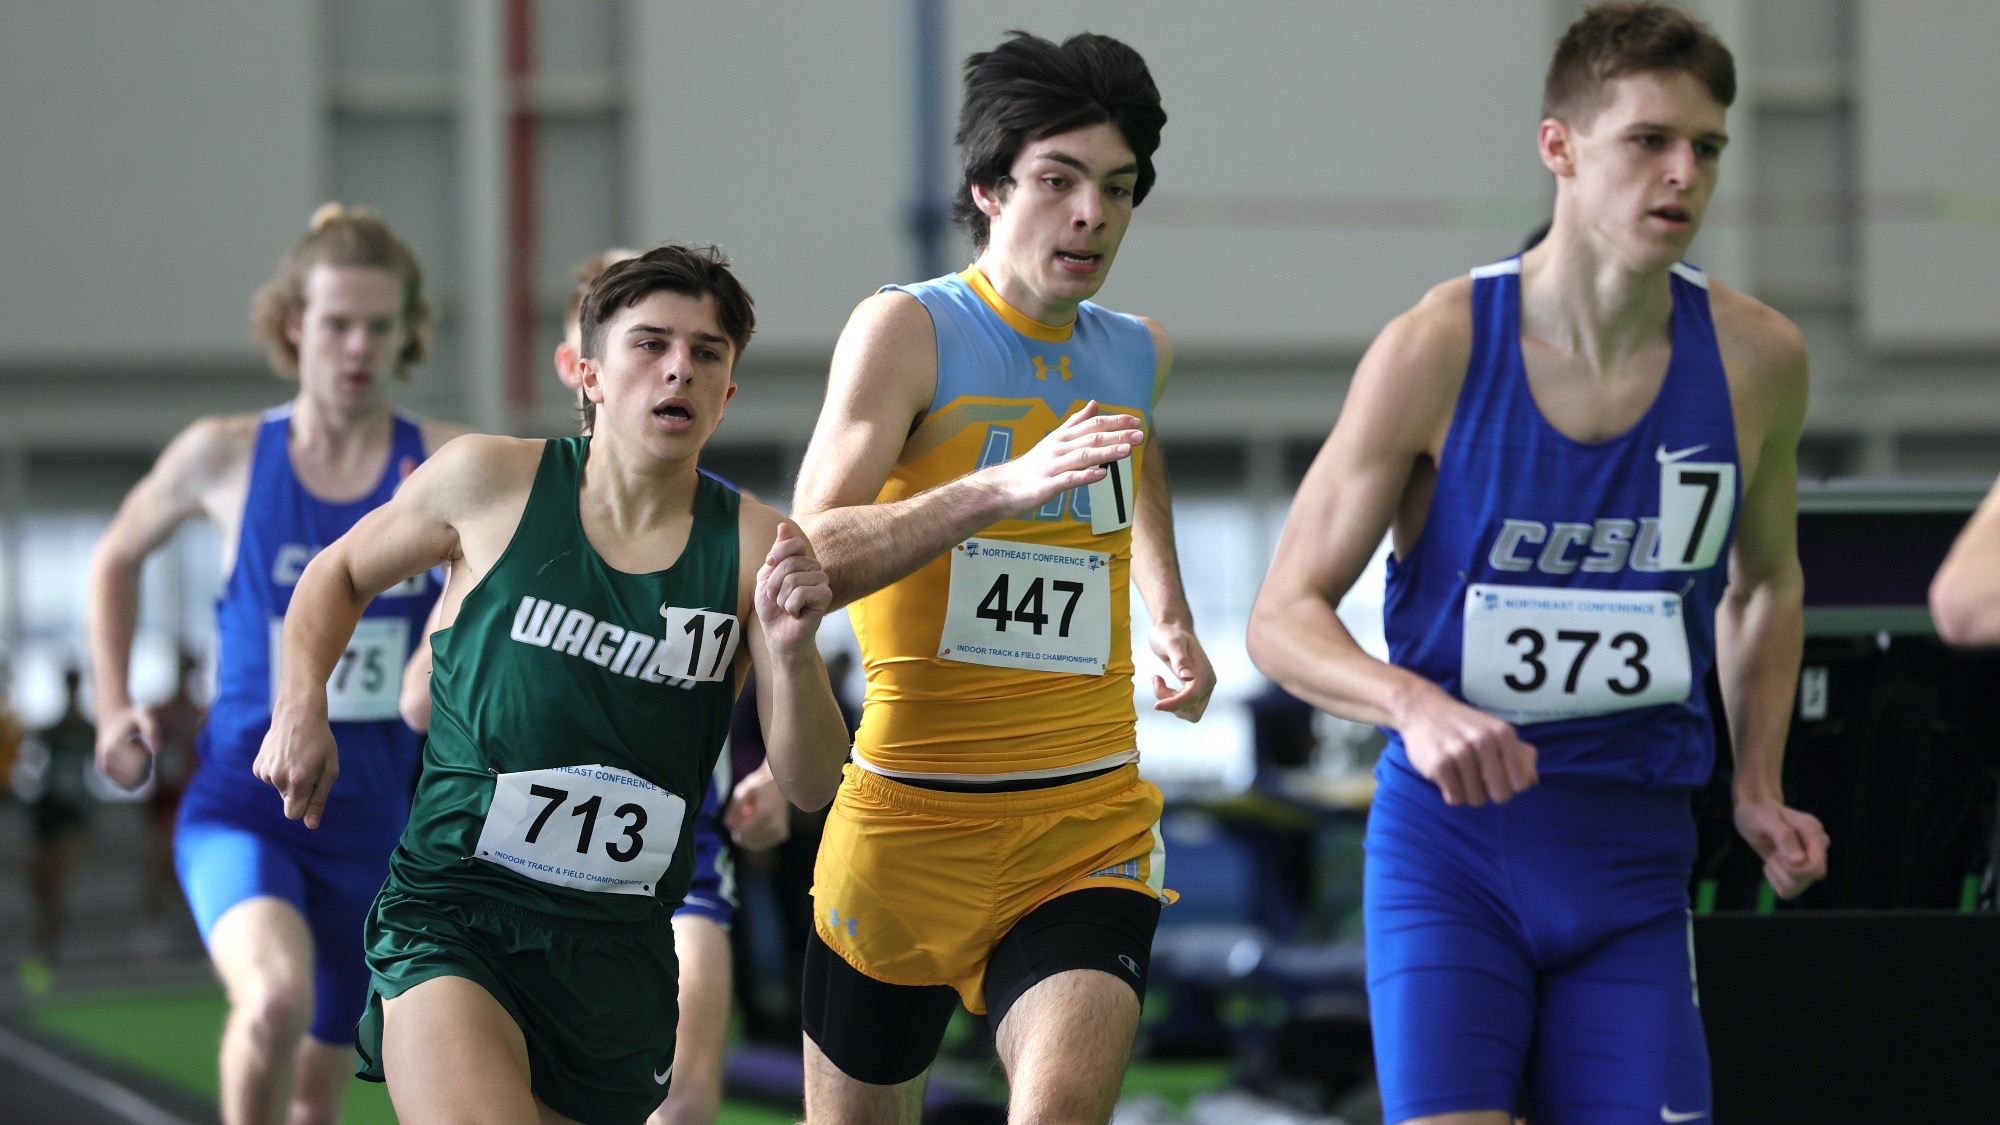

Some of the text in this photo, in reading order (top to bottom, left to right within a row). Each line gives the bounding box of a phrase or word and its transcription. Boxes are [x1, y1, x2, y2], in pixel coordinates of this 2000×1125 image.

[1099, 460, 1126, 524] 1
[1679, 471, 1720, 564] 7
[982, 548, 1085, 567] NORTHEAST CONFERENCE
[976, 573, 1084, 638] 447
[335, 647, 386, 694] 75
[511, 596, 697, 690] WAGNE
[684, 614, 735, 678] 11
[956, 645, 987, 655] INDOOR
[988, 648, 1013, 658] TRACK
[1021, 651, 1041, 660] FIELD
[1042, 653, 1098, 665] CHAMPIONSHIPS
[1503, 628, 1651, 696] 373
[595, 771, 658, 791] CONFERENCE
[524, 784, 648, 863] 713
[494, 850, 526, 866] INDOOR
[527, 861, 555, 873] TRACK
[562, 869, 585, 879] FIELD
[586, 873, 644, 885] CHAMPIONSHIPS
